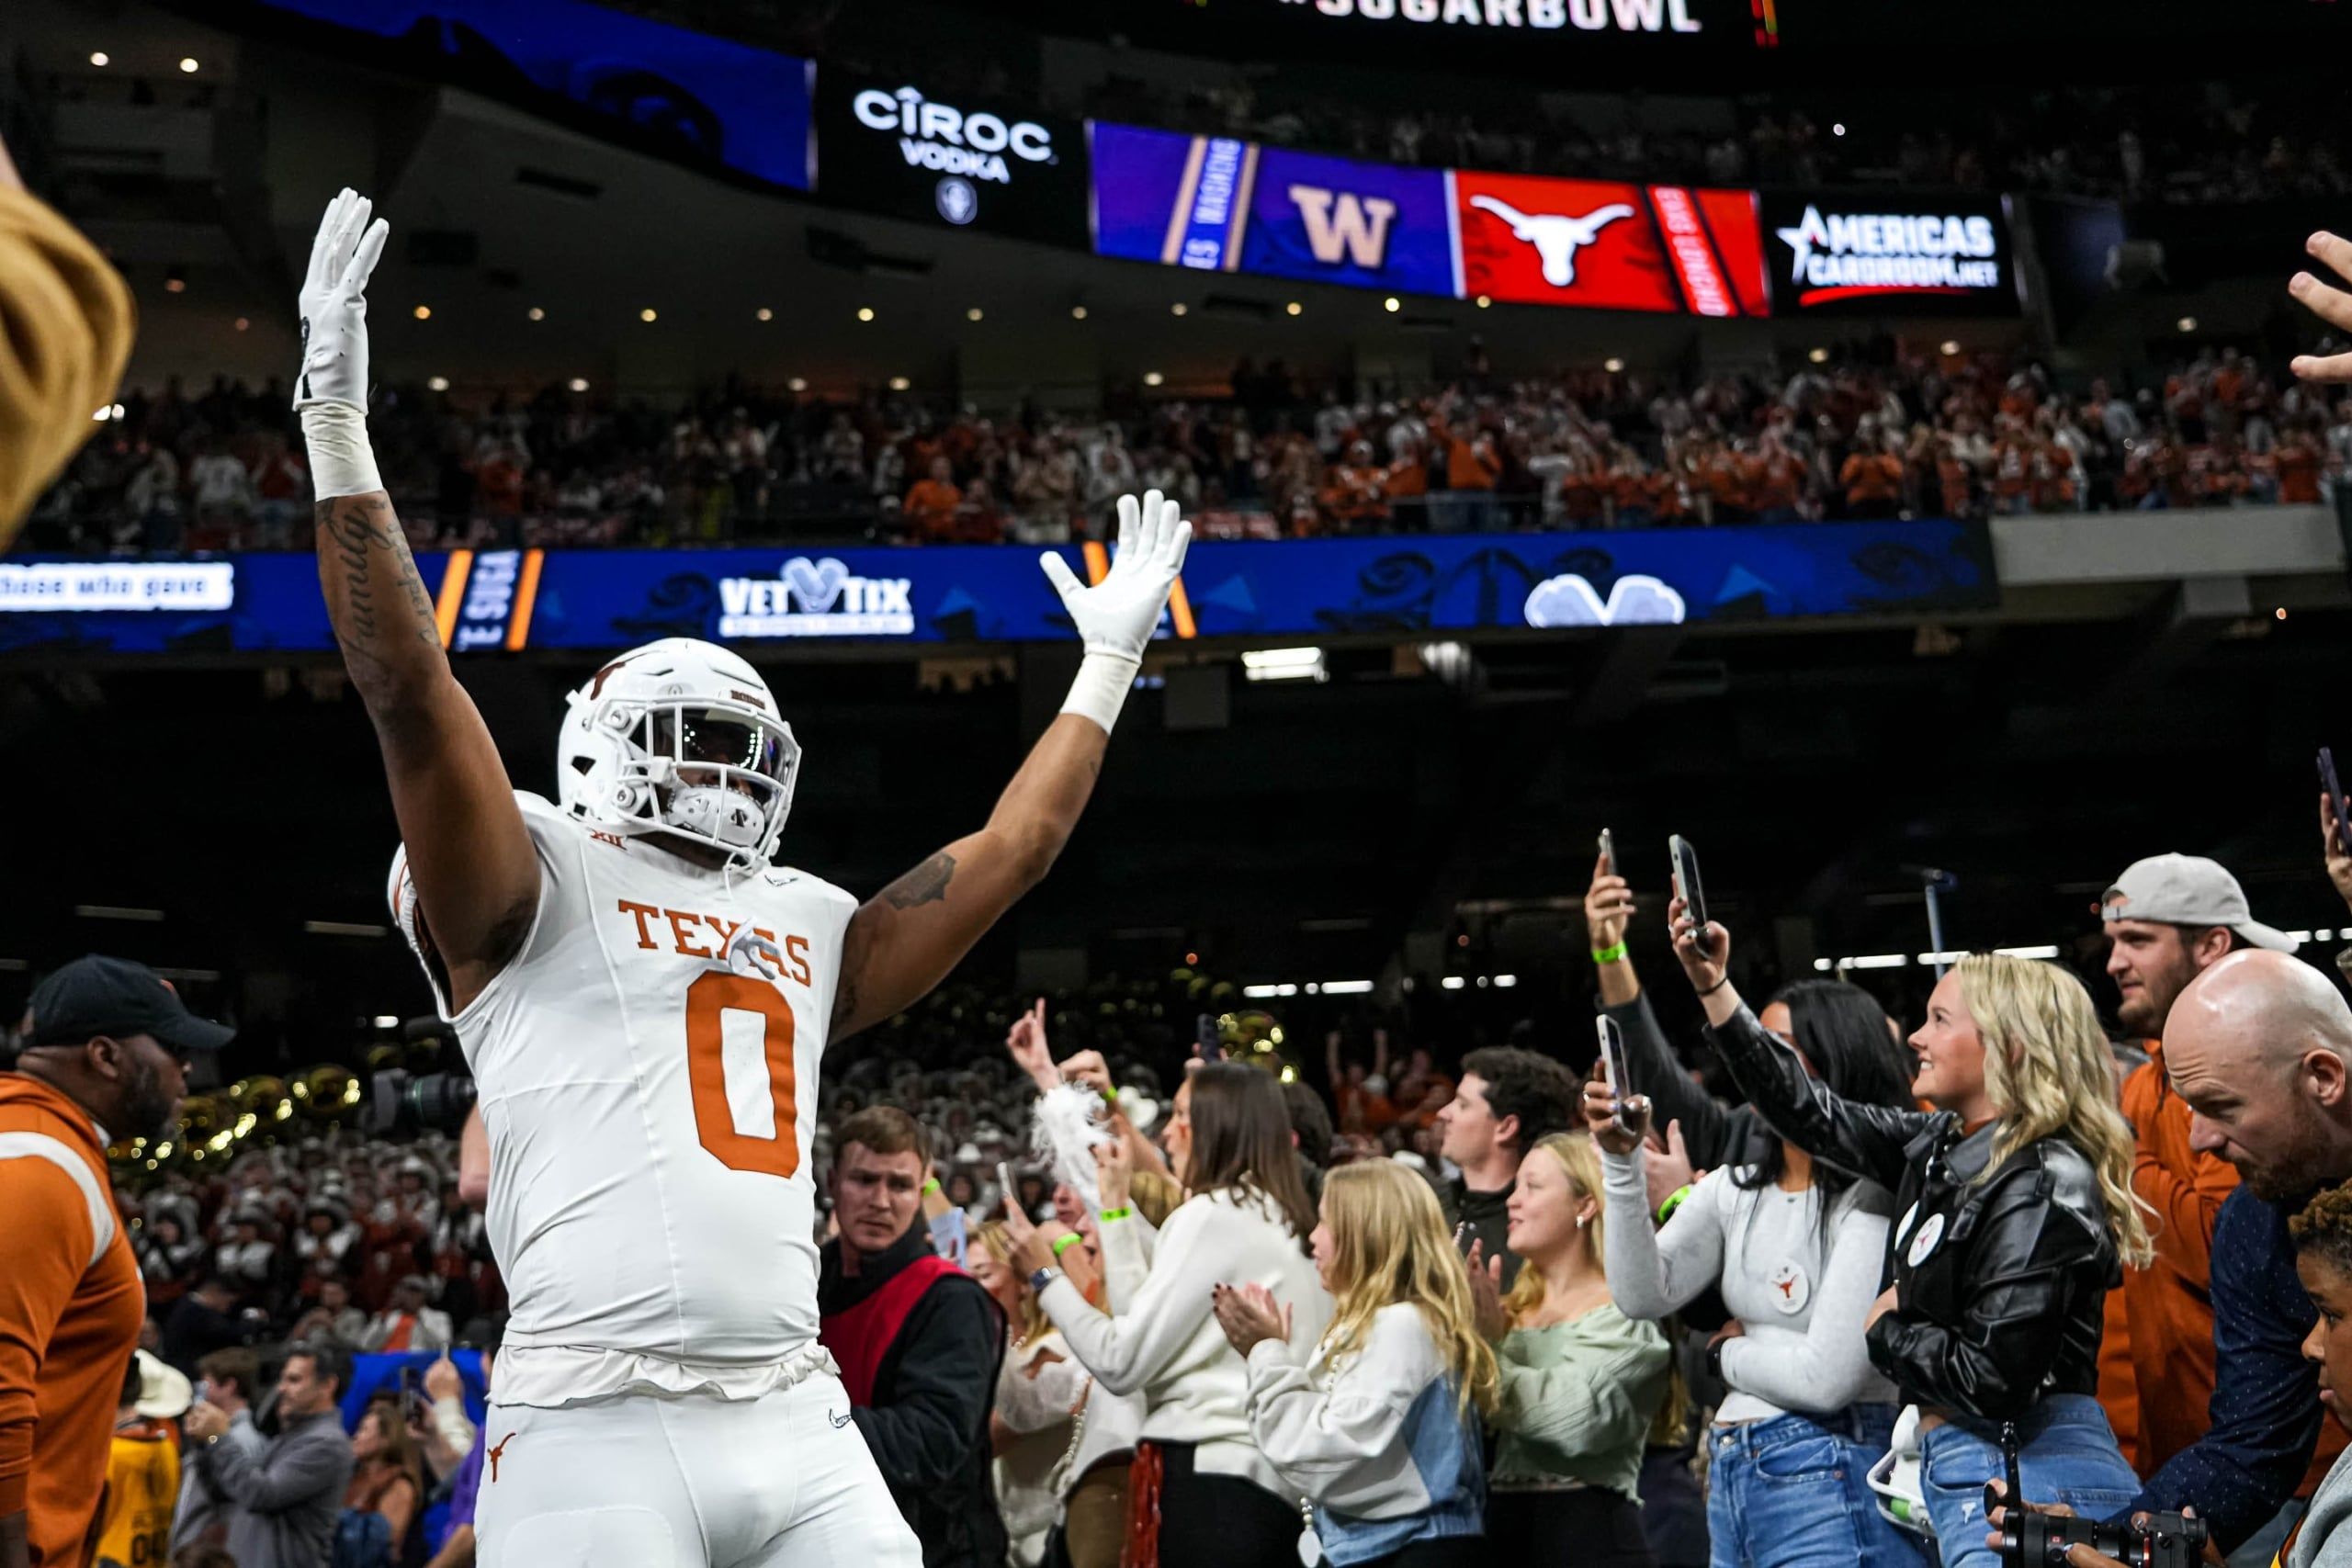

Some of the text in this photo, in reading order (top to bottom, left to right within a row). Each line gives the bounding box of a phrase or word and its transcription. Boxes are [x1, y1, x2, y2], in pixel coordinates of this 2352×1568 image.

[899, 138, 1011, 184] VODKA
[1287, 184, 1396, 269] W
[1777, 204, 1996, 258] AMERICAS
[719, 576, 913, 616] VET TIX
[617, 898, 811, 988] TEXAS
[684, 968, 800, 1179] 0
